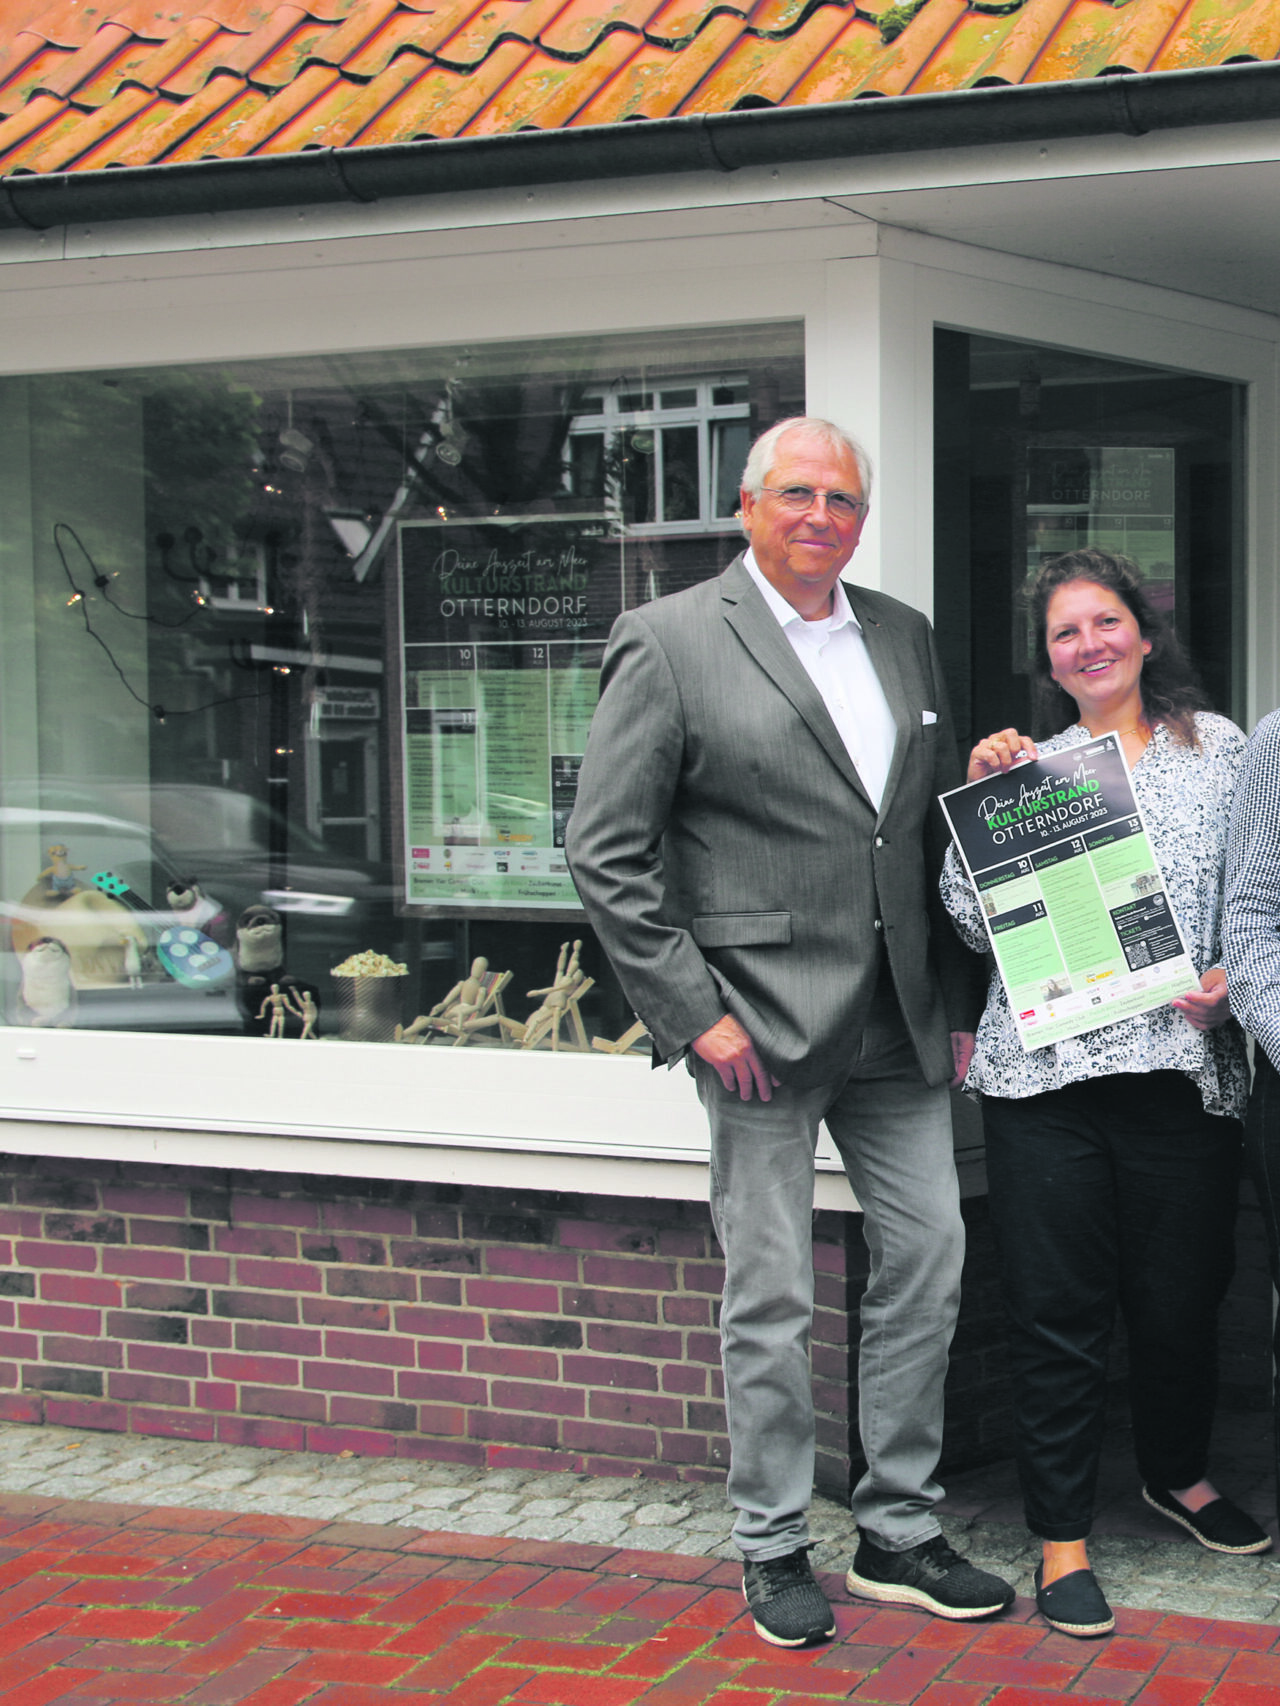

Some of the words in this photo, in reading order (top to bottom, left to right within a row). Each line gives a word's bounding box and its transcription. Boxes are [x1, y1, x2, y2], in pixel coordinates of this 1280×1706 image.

[1052, 489, 1151, 501] OTTERNDORF
[432, 549, 479, 580] Deine
[482, 548, 536, 580] Auszeit
[441, 574, 588, 595] KULTURSTRAND
[440, 596, 588, 618] OTTERNDORF
[529, 618, 564, 628] AUGUST
[566, 618, 588, 628] 2023
[459, 649, 472, 660] 10
[532, 648, 544, 658] 12
[462, 713, 473, 724] 11
[978, 795, 1016, 822] Deine
[1018, 774, 1053, 808] Auszeit
[986, 779, 1100, 831] KULTURSTRAND
[992, 792, 1104, 845] OTTERNDORF
[1062, 816, 1090, 830] AUGUST
[1090, 806, 1108, 820] 2023
[1127, 818, 1140, 828] 13
[1071, 839, 1082, 849] 12
[1017, 860, 1028, 870] 10
[1032, 902, 1043, 912] 11
[1112, 902, 1136, 916] KONTAKT
[1120, 926, 1142, 937] TICKETS
